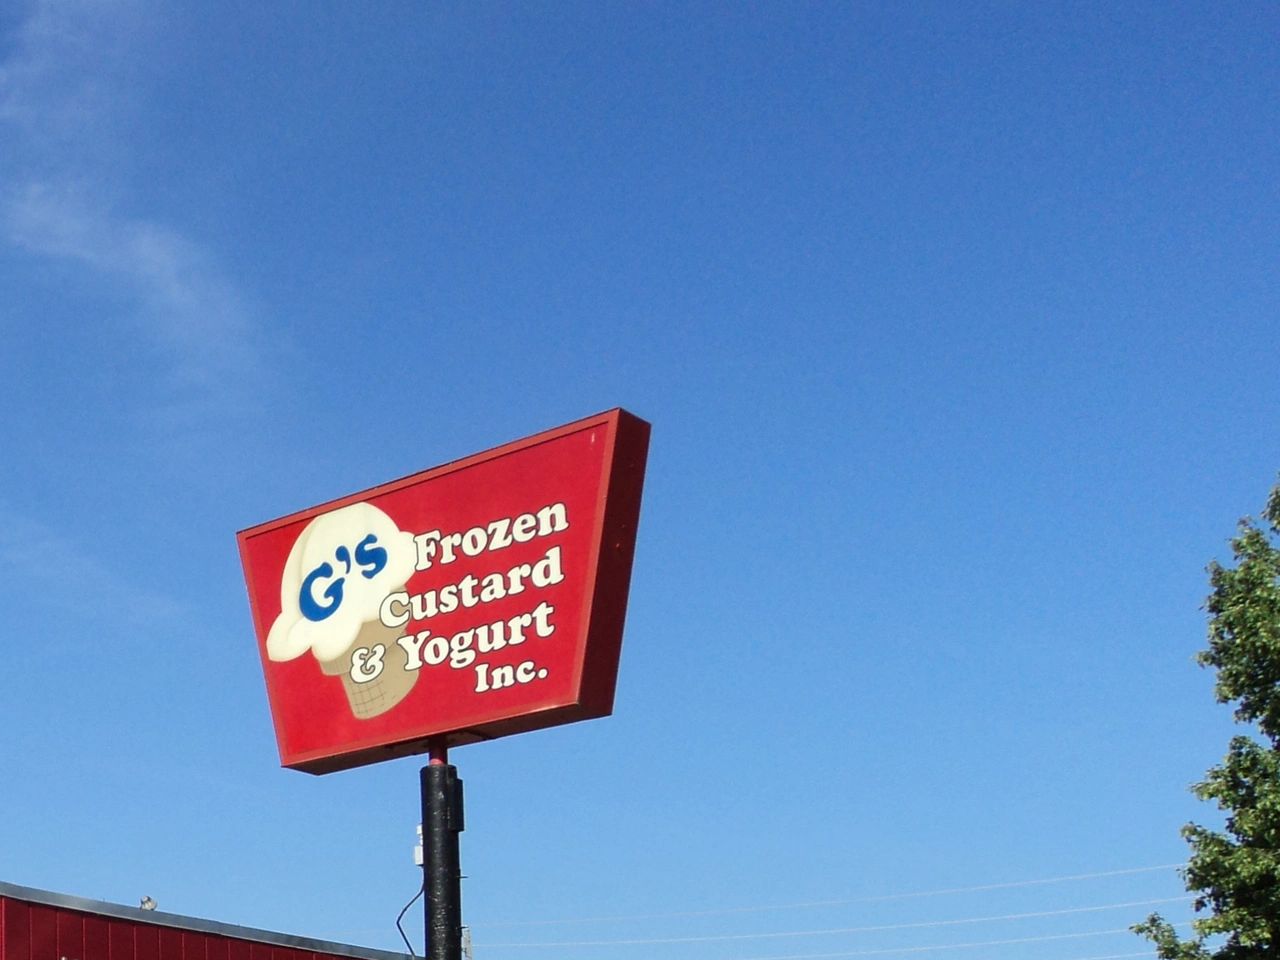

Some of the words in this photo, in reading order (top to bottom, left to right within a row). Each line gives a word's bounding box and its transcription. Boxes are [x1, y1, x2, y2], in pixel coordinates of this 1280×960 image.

[298, 533, 388, 622] G's
[413, 502, 569, 572] Frozen
[379, 546, 565, 629] Custard
[350, 643, 386, 685] &
[396, 601, 556, 672] Yogurt
[474, 660, 549, 693] Inc.
